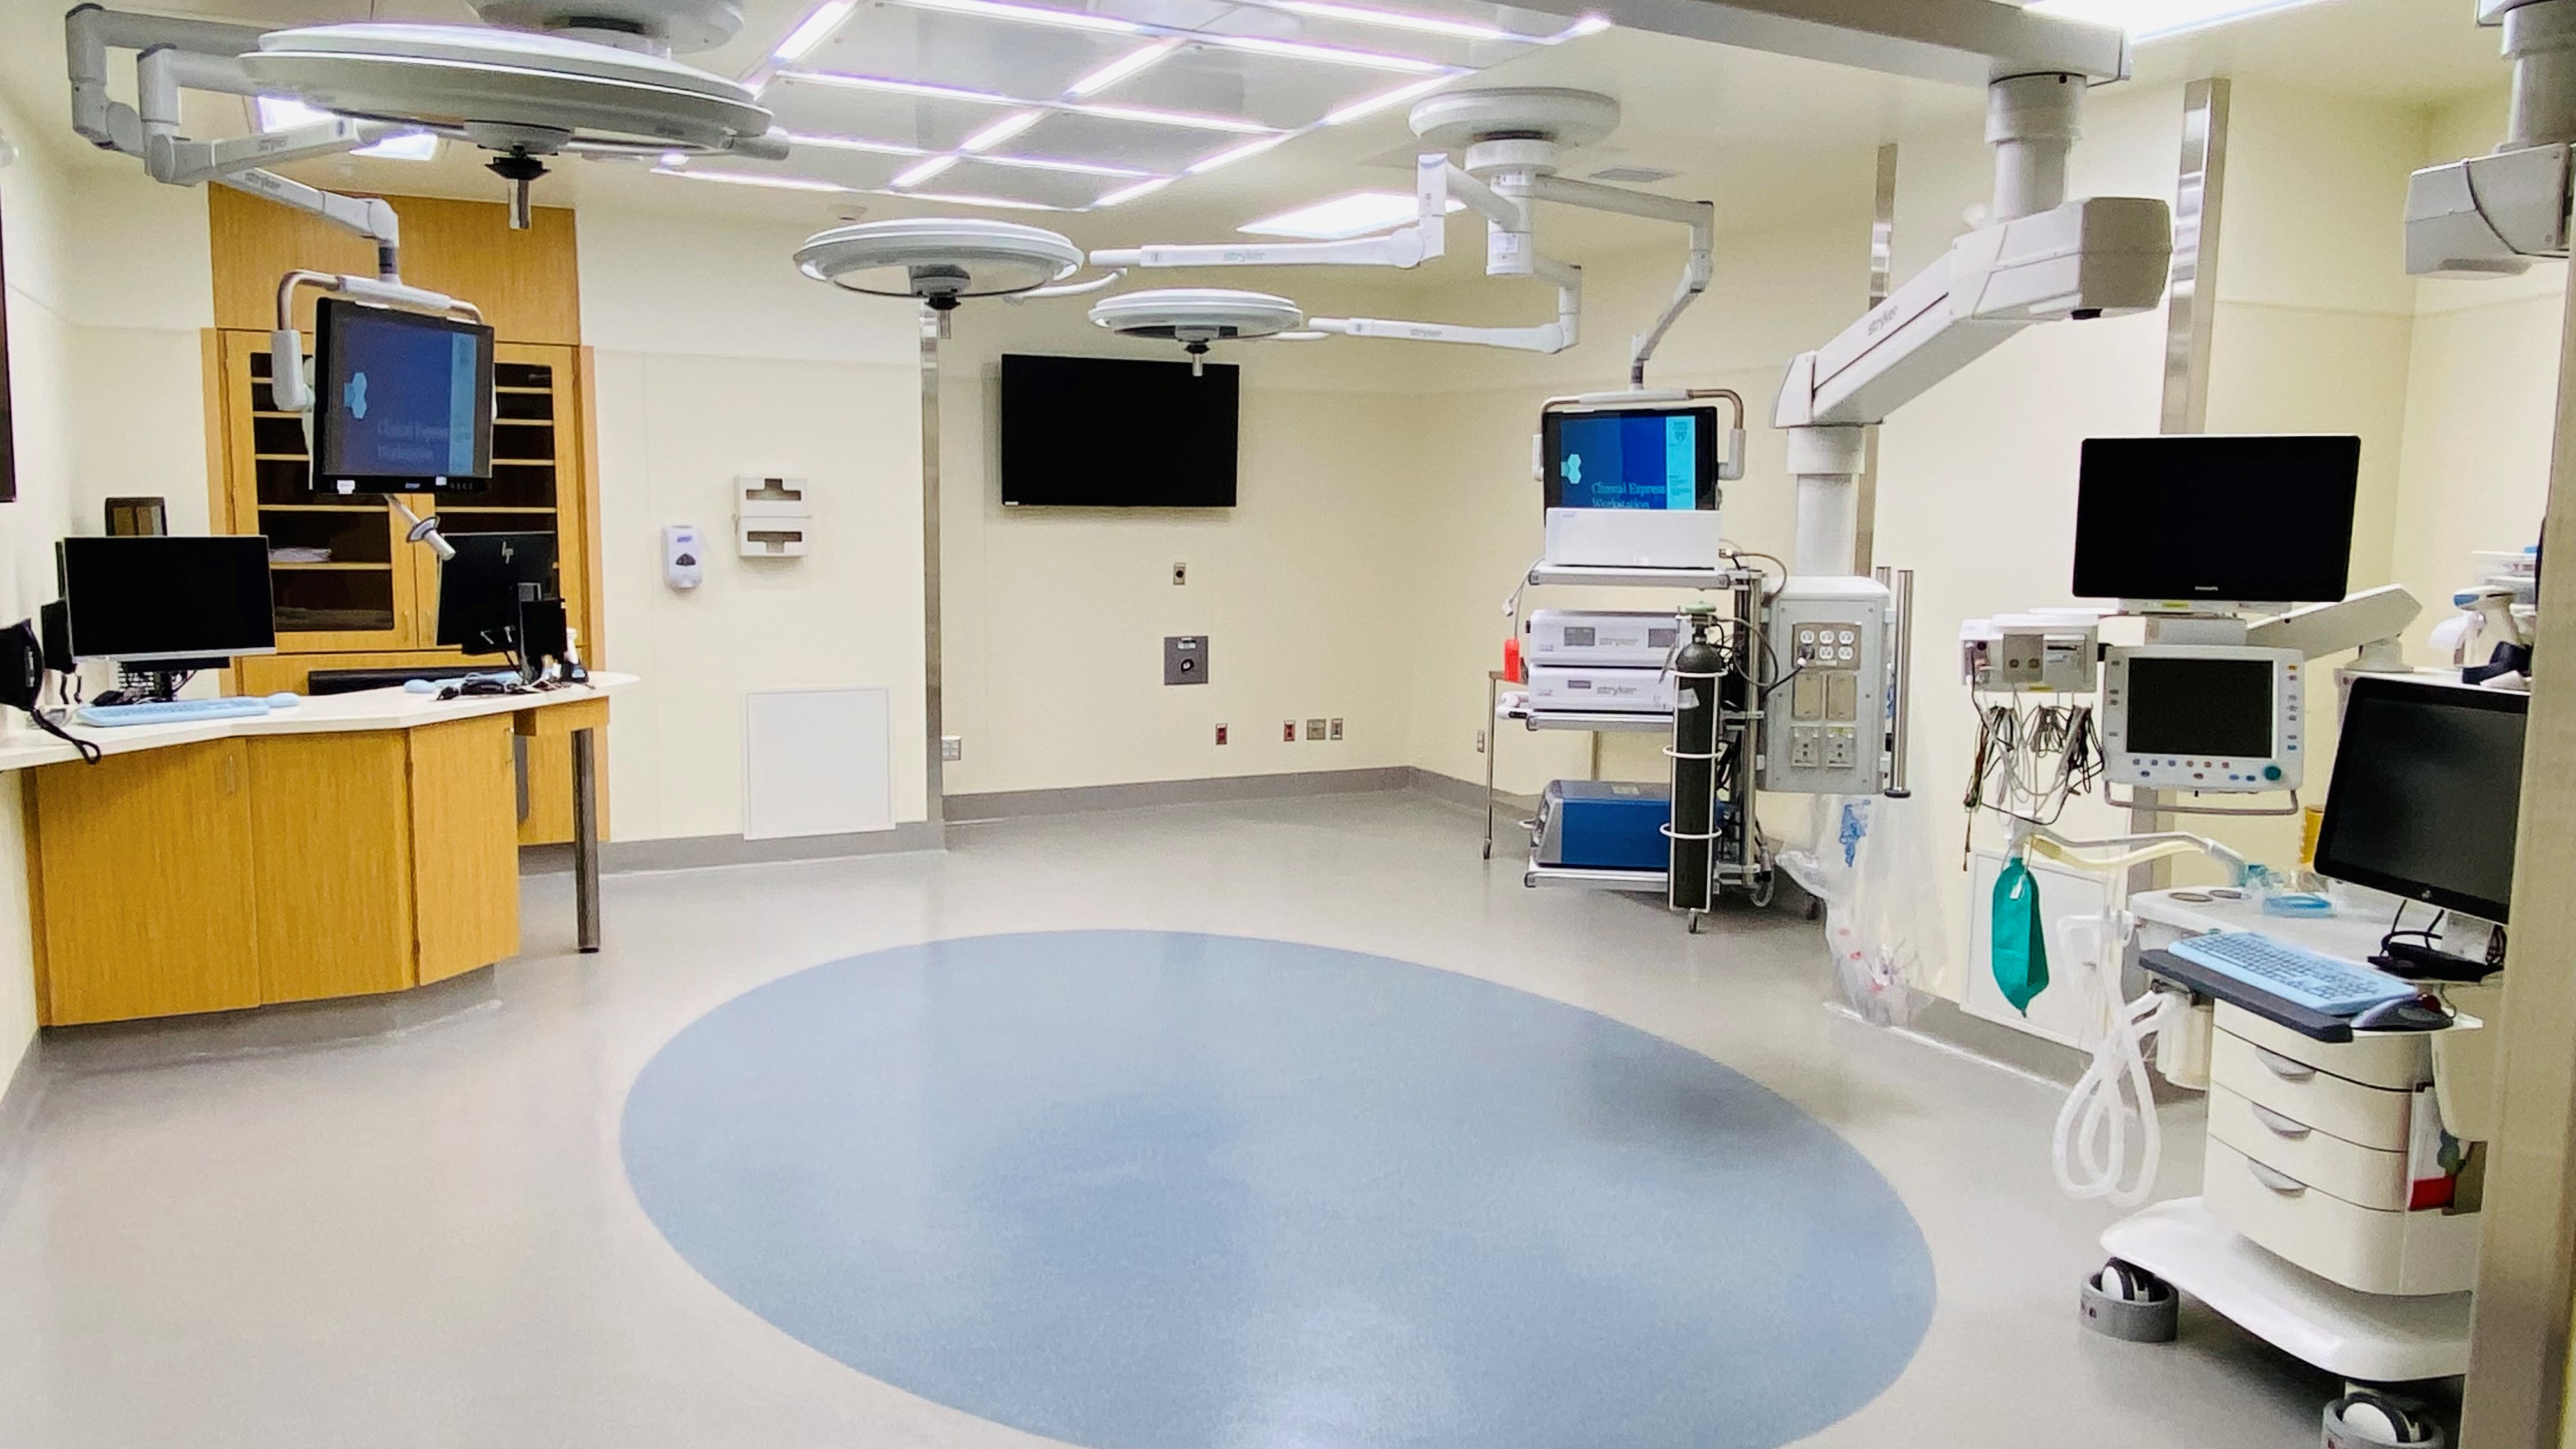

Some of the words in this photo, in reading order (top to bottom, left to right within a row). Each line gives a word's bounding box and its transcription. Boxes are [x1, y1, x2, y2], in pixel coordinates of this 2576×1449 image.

[1223, 250, 1266, 263] stryker
[1867, 305, 1898, 337] stryker
[1597, 686, 1637, 696] stryker
